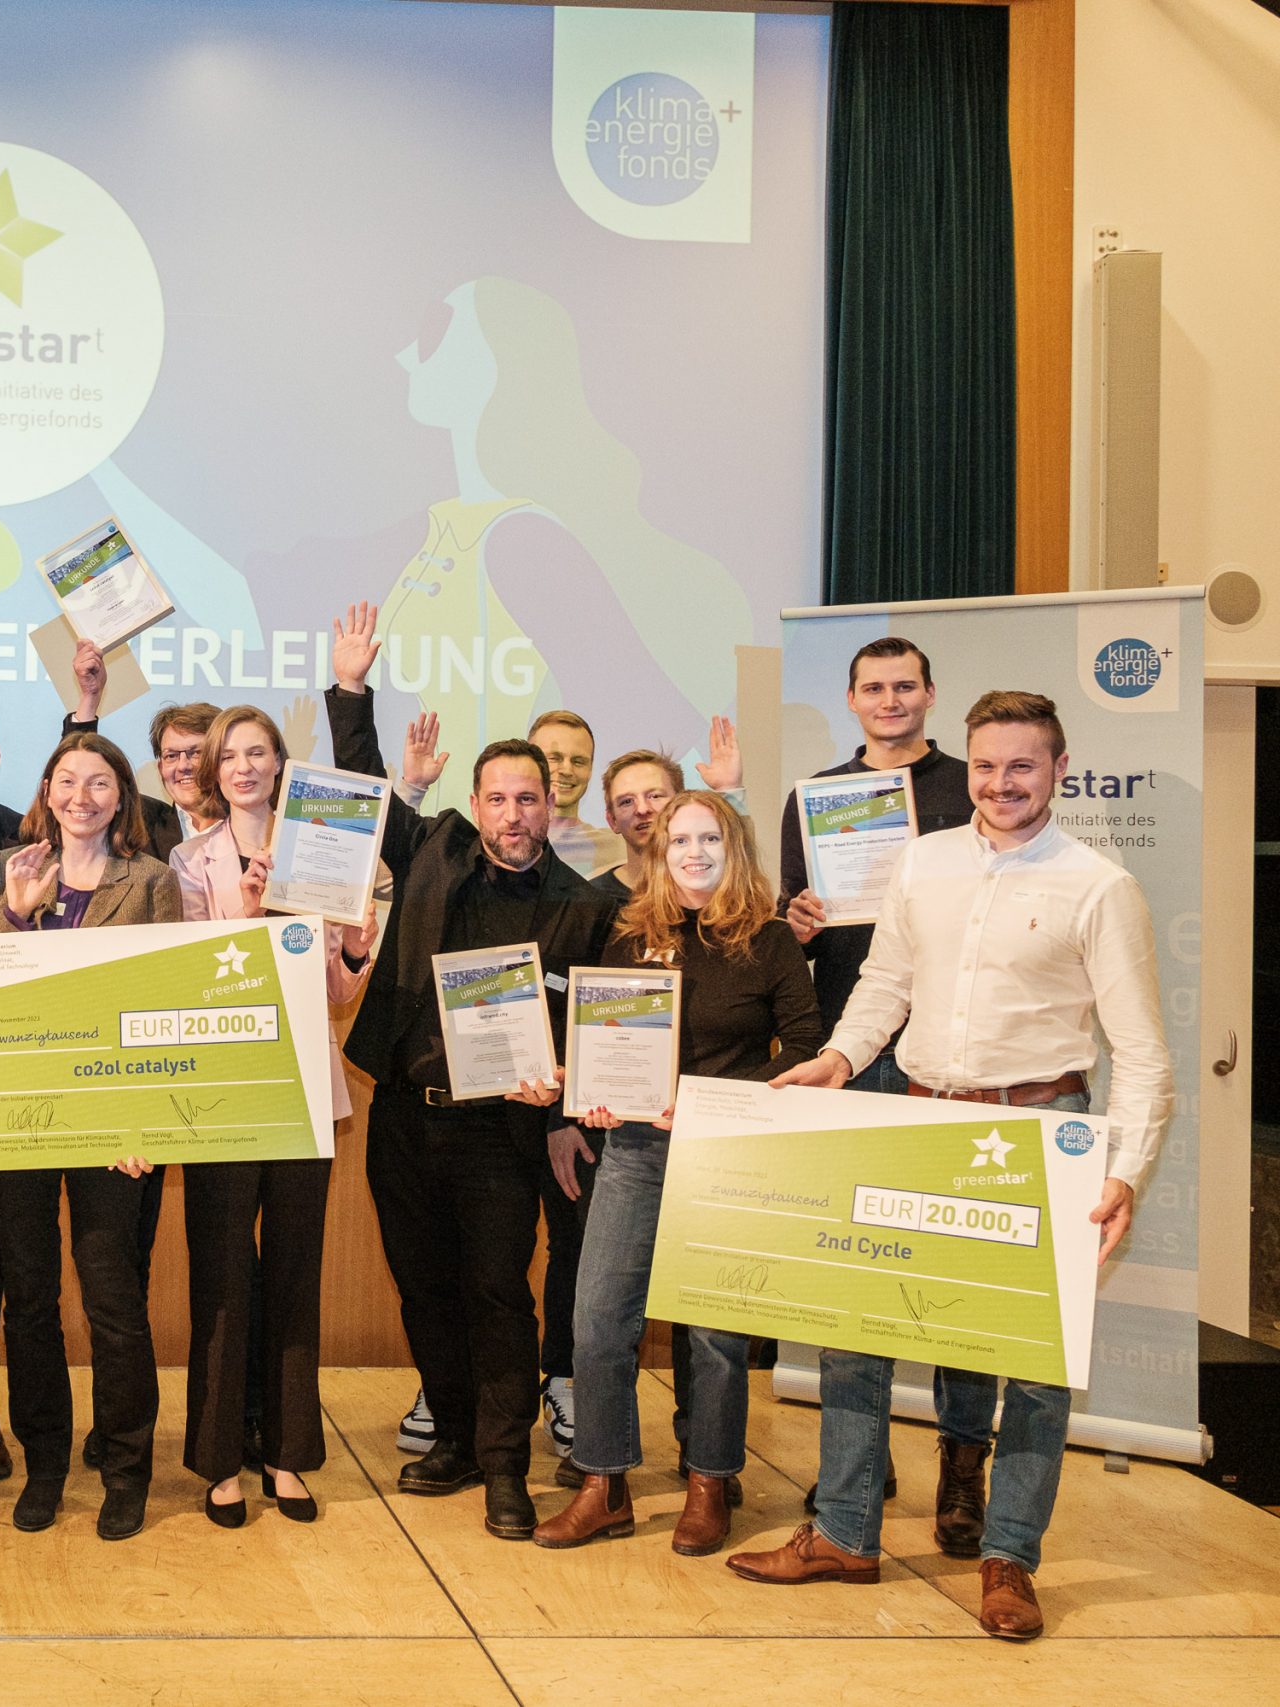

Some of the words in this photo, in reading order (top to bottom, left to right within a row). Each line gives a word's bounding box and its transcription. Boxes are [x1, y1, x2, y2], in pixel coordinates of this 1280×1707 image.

[616, 87, 713, 122] klima
[586, 119, 713, 155] energie
[617, 145, 711, 181] fonds
[68, 385, 102, 402] des
[68, 556, 101, 584] URKUNDE
[1108, 645, 1158, 661] klima
[1093, 659, 1158, 675] energie
[1110, 671, 1157, 687] fonds
[301, 803, 344, 813] URKUNDE
[826, 806, 870, 825] URKUNDE
[1057, 812, 1121, 826] Initiative
[1127, 813, 1156, 826] des
[460, 980, 502, 999] URKUNDE
[592, 1003, 637, 1016] URKUNDE
[130, 1018, 173, 1038] EUR
[184, 1014, 273, 1037] 20.000,-
[74, 1059, 121, 1077] co2ol
[126, 1057, 196, 1076] catalyst
[710, 1185, 830, 1208] zwanzigtausend
[864, 1195, 914, 1221] EUR
[926, 1203, 1033, 1239] 20.000,-
[816, 1231, 852, 1251] 2nd
[857, 1237, 912, 1260] Cycle
